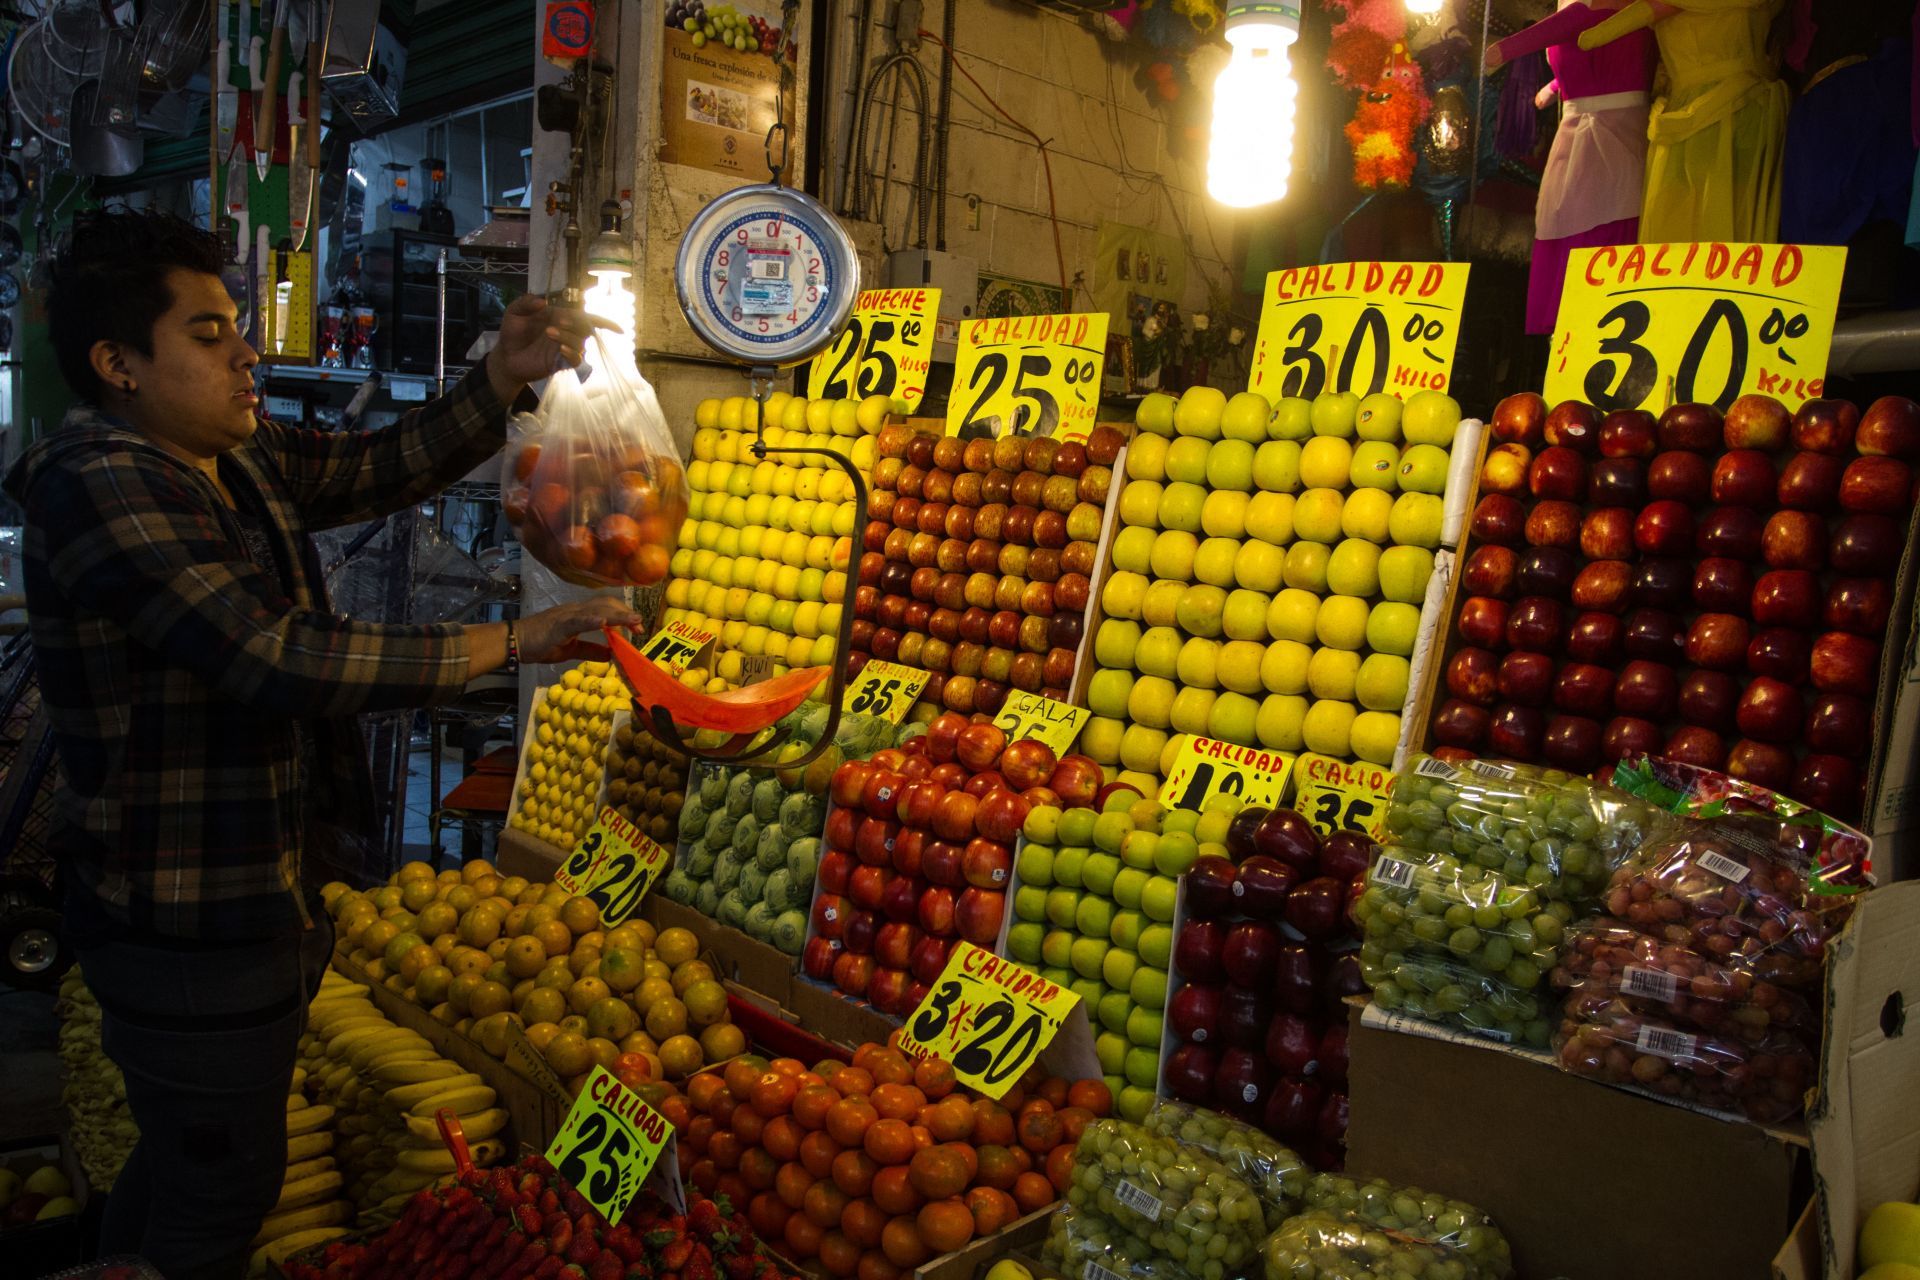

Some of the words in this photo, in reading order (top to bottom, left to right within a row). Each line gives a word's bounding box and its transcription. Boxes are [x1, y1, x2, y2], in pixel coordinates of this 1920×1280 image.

[673, 47, 691, 61] Una
[693, 52, 717, 68] fresca
[719, 62, 755, 79] explosión
[737, 229, 749, 246] 9
[795, 234, 803, 250] 1
[718, 250, 730, 267] 8
[808, 258, 820, 275] 2
[1585, 241, 1803, 287] CALIDAD
[717, 280, 728, 295] 7
[806, 286, 818, 303] 3
[1278, 262, 1444, 300] CALIDAD
[731, 306, 743, 322] 6
[758, 317, 769, 333] 5
[786, 309, 798, 325] 4
[970, 314, 1089, 346] CALIDAD
[821, 318, 897, 401] 25
[1281, 307, 1390, 403] 30
[1583, 299, 1748, 413] 30
[1394, 364, 1446, 391] KILO
[1757, 367, 1824, 400] KILO
[957, 352, 1059, 442] 25
[1063, 401, 1095, 420] KILO
[667, 620, 712, 644] CALIDAD
[851, 678, 902, 717] 35
[1018, 694, 1079, 729] GALA
[1193, 737, 1284, 774] CALIDAD
[600, 807, 660, 865] CALIDAD
[963, 948, 1060, 1004] CALIDAD
[591, 1073, 666, 1145] CALIDAD
[558, 1112, 630, 1205] 25
